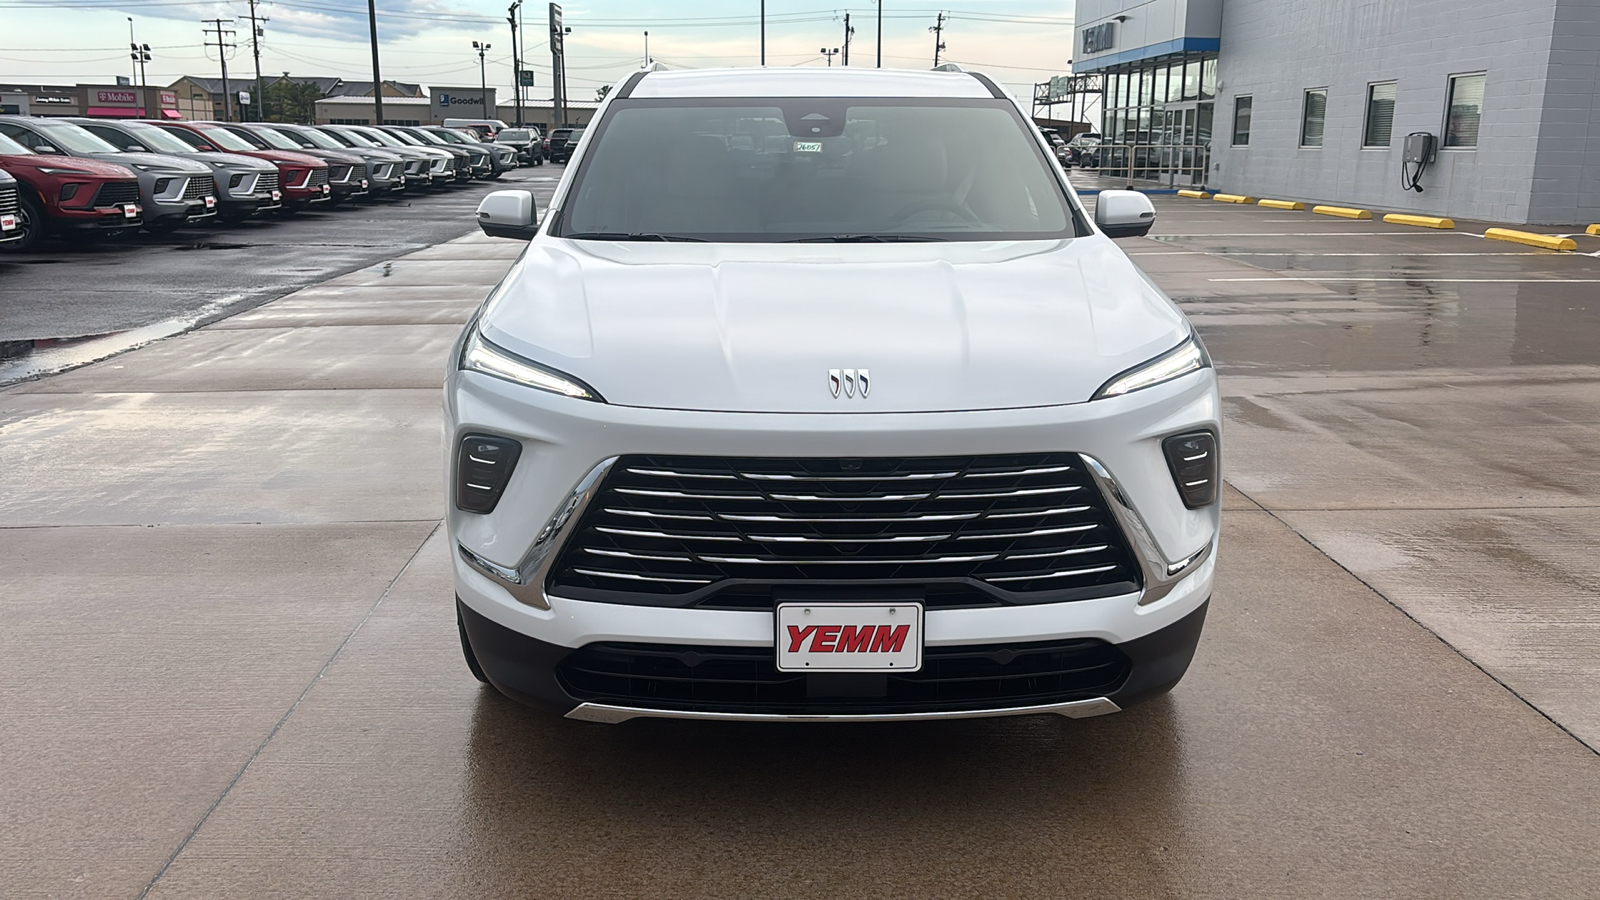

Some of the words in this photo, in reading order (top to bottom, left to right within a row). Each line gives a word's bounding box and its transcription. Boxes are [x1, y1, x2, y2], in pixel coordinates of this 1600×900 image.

[107, 92, 134, 102] Mobile
[450, 97, 485, 105] Goodwil
[787, 625, 911, 653] YEMM
